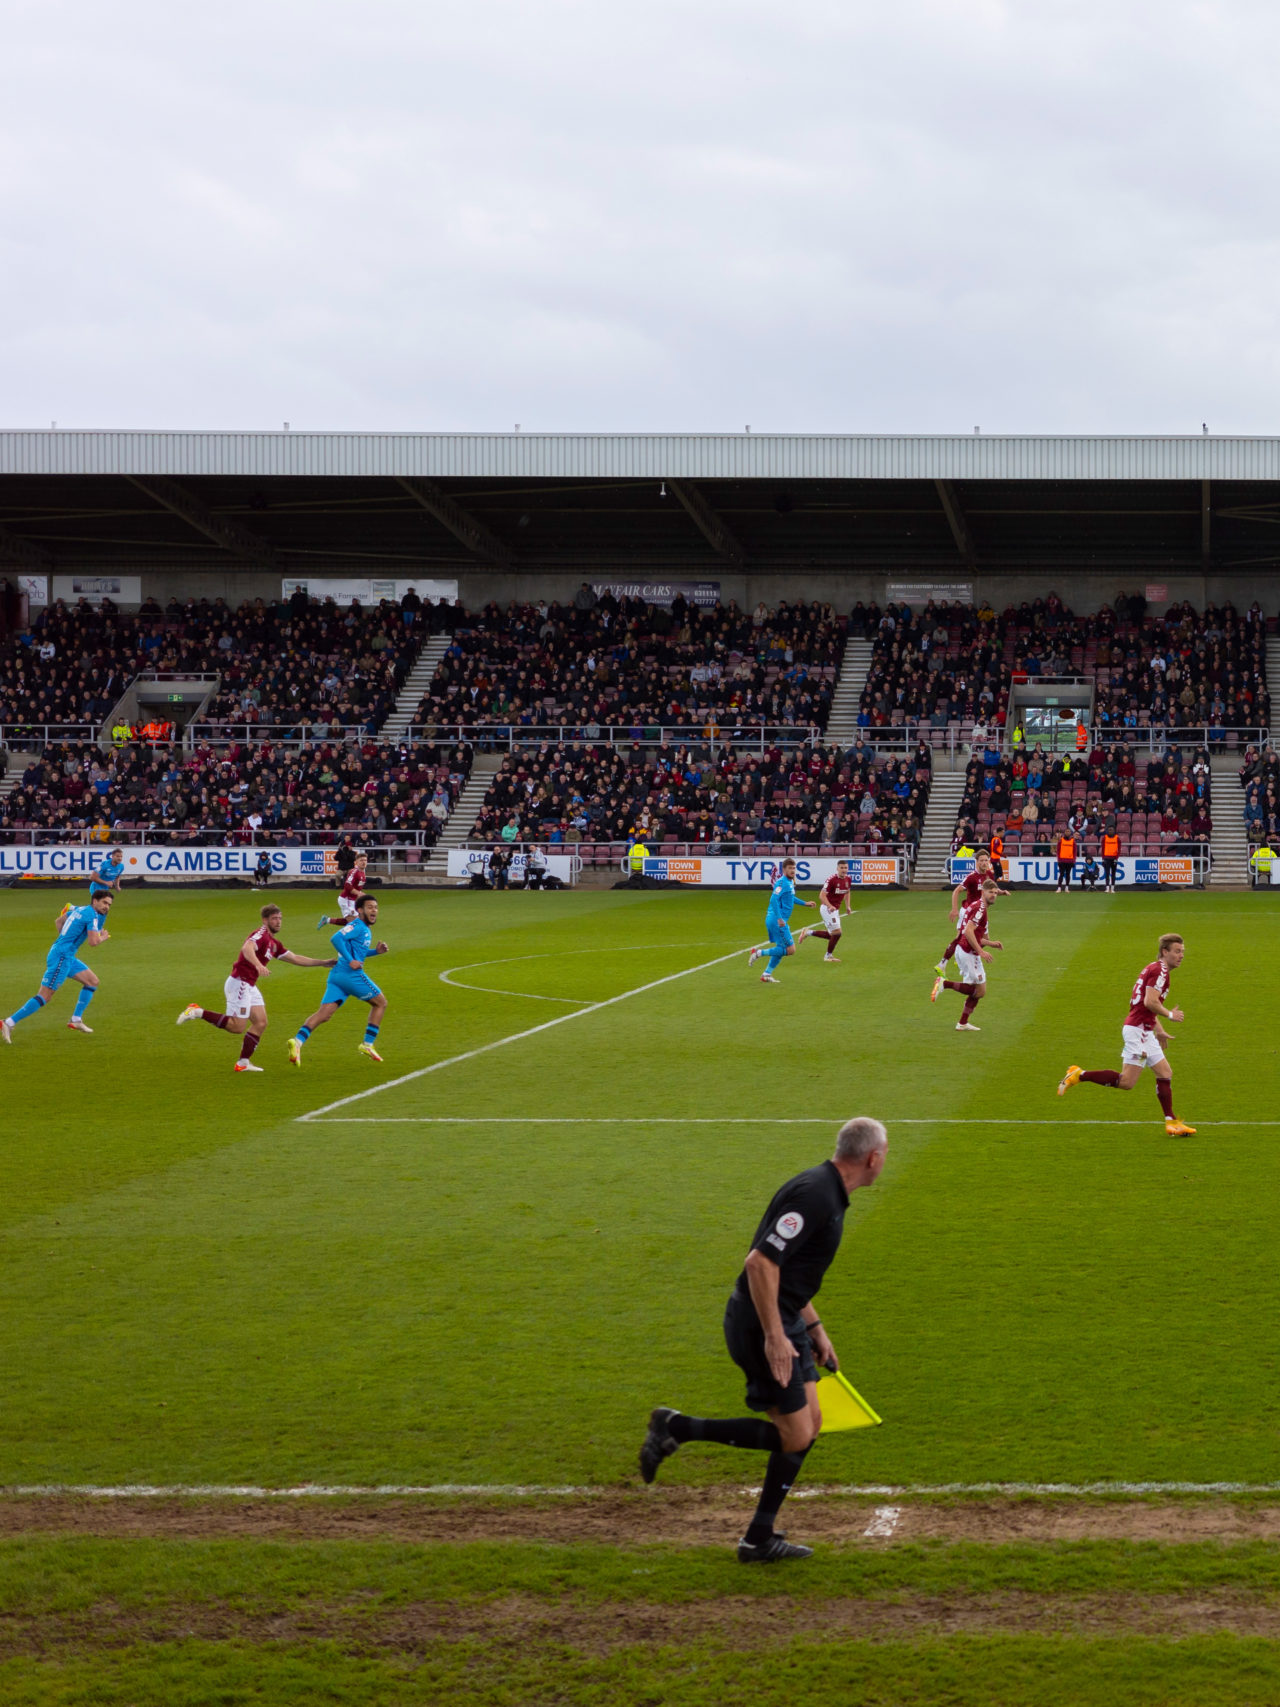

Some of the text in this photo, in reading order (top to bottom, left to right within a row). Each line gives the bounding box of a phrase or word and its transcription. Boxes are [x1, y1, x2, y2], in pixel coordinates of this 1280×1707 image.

[642, 585, 671, 596] CARS
[1136, 873, 1192, 881] AUTO MOTIVE
